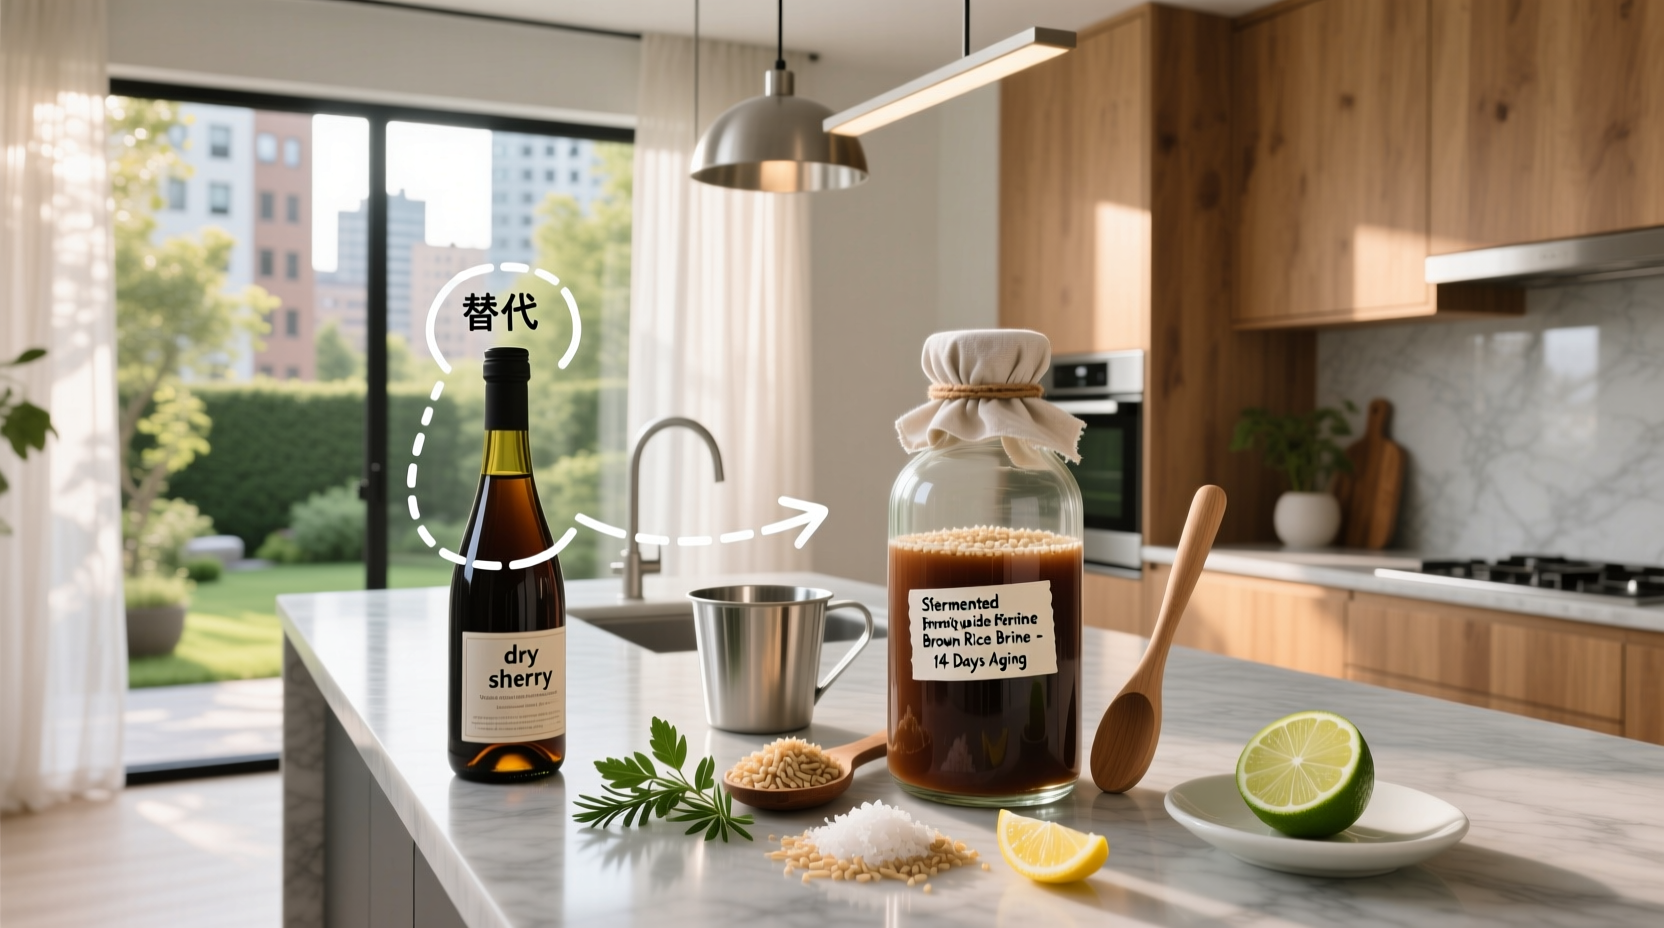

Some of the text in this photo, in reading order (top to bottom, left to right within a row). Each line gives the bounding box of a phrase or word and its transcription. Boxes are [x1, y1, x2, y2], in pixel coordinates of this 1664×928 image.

[923, 633, 960, 648] Brown
[964, 631, 992, 646] Rice
[996, 630, 1031, 645] Brine
[504, 643, 539, 668] dry
[934, 651, 1027, 674] 14 Days Aging
[489, 669, 553, 691] sherry
